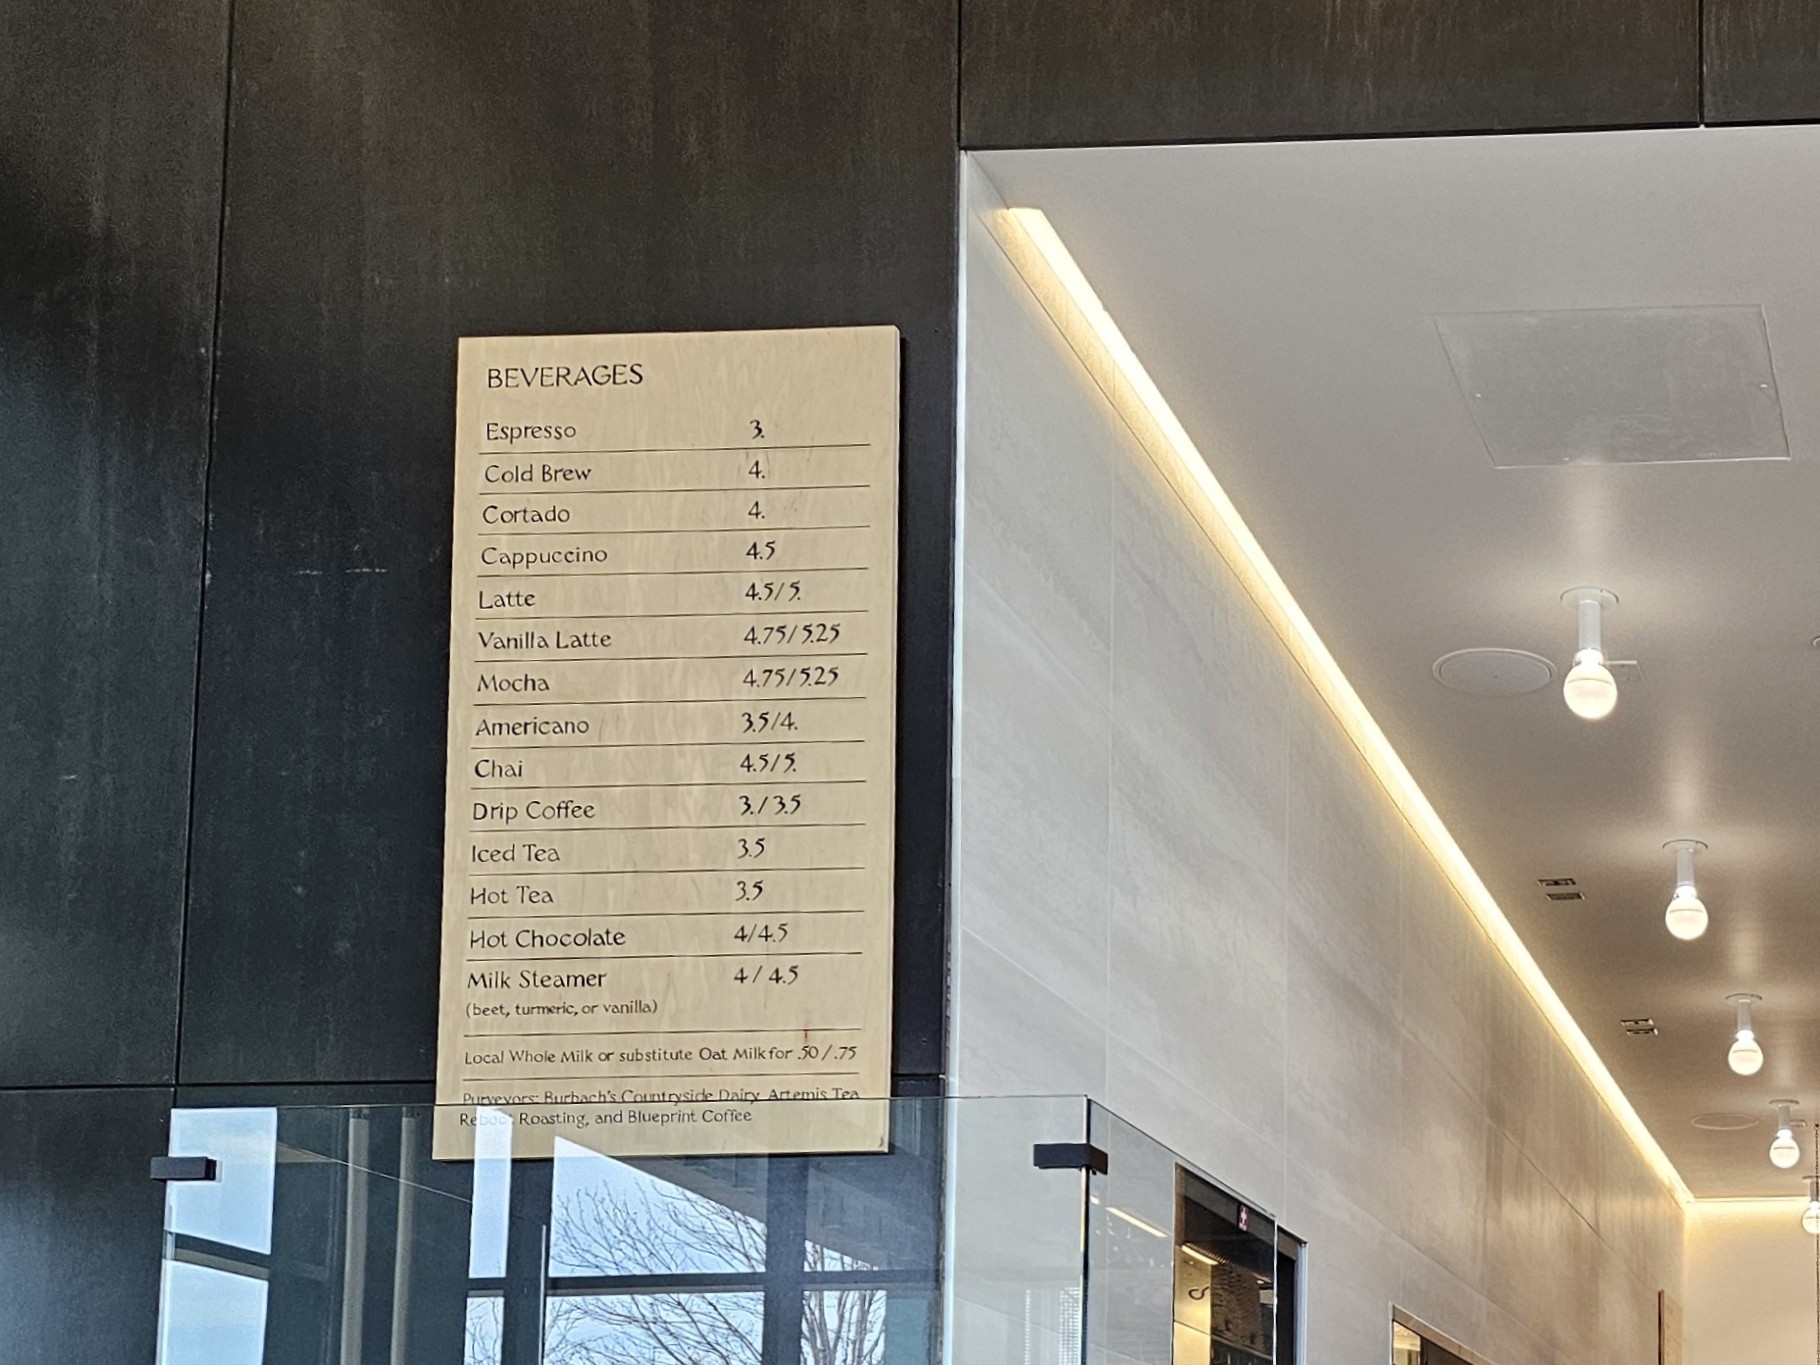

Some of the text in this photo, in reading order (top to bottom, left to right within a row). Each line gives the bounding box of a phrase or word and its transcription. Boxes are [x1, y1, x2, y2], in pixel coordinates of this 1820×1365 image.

[489, 364, 643, 388] BEVERAGES
[487, 423, 576, 444] Espresso
[485, 464, 532, 483] Cold
[542, 465, 591, 482] Brew
[483, 505, 570, 524] Cortado
[482, 541, 775, 569] Cappuccino 4.5
[480, 591, 535, 609] Latte
[478, 632, 549, 649] Vanilla
[557, 631, 611, 648] Latte
[477, 674, 549, 692] Mocha
[476, 717, 589, 736] Americano
[475, 760, 522, 778] Chai
[474, 803, 518, 824] Drip
[526, 800, 594, 819] Coffee
[473, 838, 765, 862] Iced Tea 3.5
[471, 880, 763, 904] Hot Tea 3.5
[471, 931, 508, 948] Hot
[516, 928, 625, 948] Chocolate
[468, 971, 510, 988] Milk
[519, 971, 606, 988] Steamer
[734, 968, 748, 983] 4
[769, 966, 798, 984] 4.5
[466, 1000, 657, 1018] (beet, turmeric, or vanilla)
[465, 1051, 504, 1064] Local
[509, 1050, 555, 1063] Whole
[561, 1050, 592, 1063] Milk
[598, 1052, 614, 1061] or
[619, 1048, 692, 1062] substitute
[699, 1047, 727, 1060] Oat
[733, 1047, 766, 1060] Milk
[769, 1047, 793, 1059] for
[798, 1045, 818, 1059] .50
[835, 1046, 857, 1059] .75
[621, 1089, 713, 1105] Countryside
[768, 1087, 827, 1100] Artemis
[520, 1112, 589, 1129] Roasting,
[595, 1110, 622, 1124] and
[629, 1110, 696, 1126] Blueprint
[702, 1109, 751, 1122] Coffee
